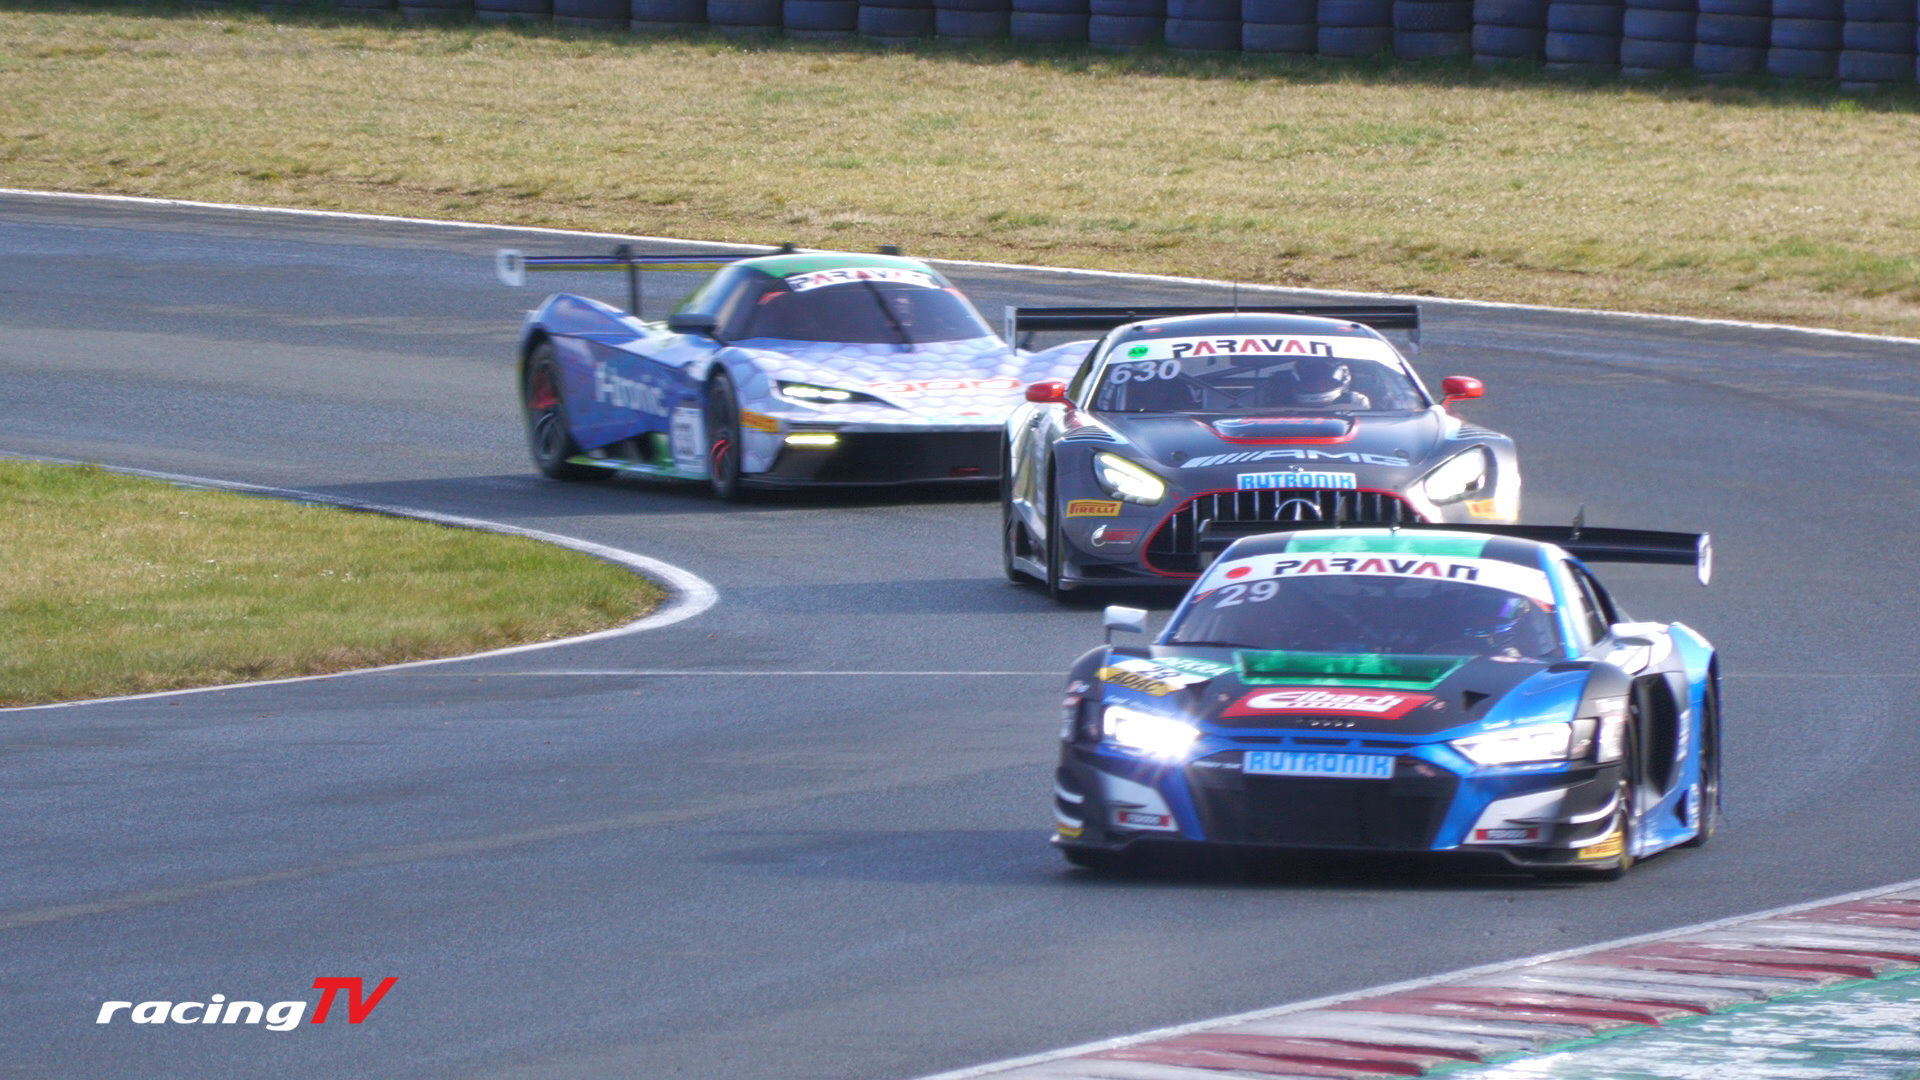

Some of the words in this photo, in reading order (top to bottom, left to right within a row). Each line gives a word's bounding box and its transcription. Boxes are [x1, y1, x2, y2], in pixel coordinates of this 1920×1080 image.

[786, 269, 940, 291] PARAV
[1172, 338, 1334, 358] PARAVAN
[1110, 359, 1182, 384] 630
[1250, 449, 1409, 467] AMG
[1241, 473, 1352, 489] RUTRONIK
[1069, 503, 1118, 514] PIRELLI
[1273, 558, 1479, 581] PARAVAN
[1214, 580, 1280, 609] 29
[1246, 690, 1409, 713] Eibach
[1250, 751, 1389, 776] RUTRONIK
